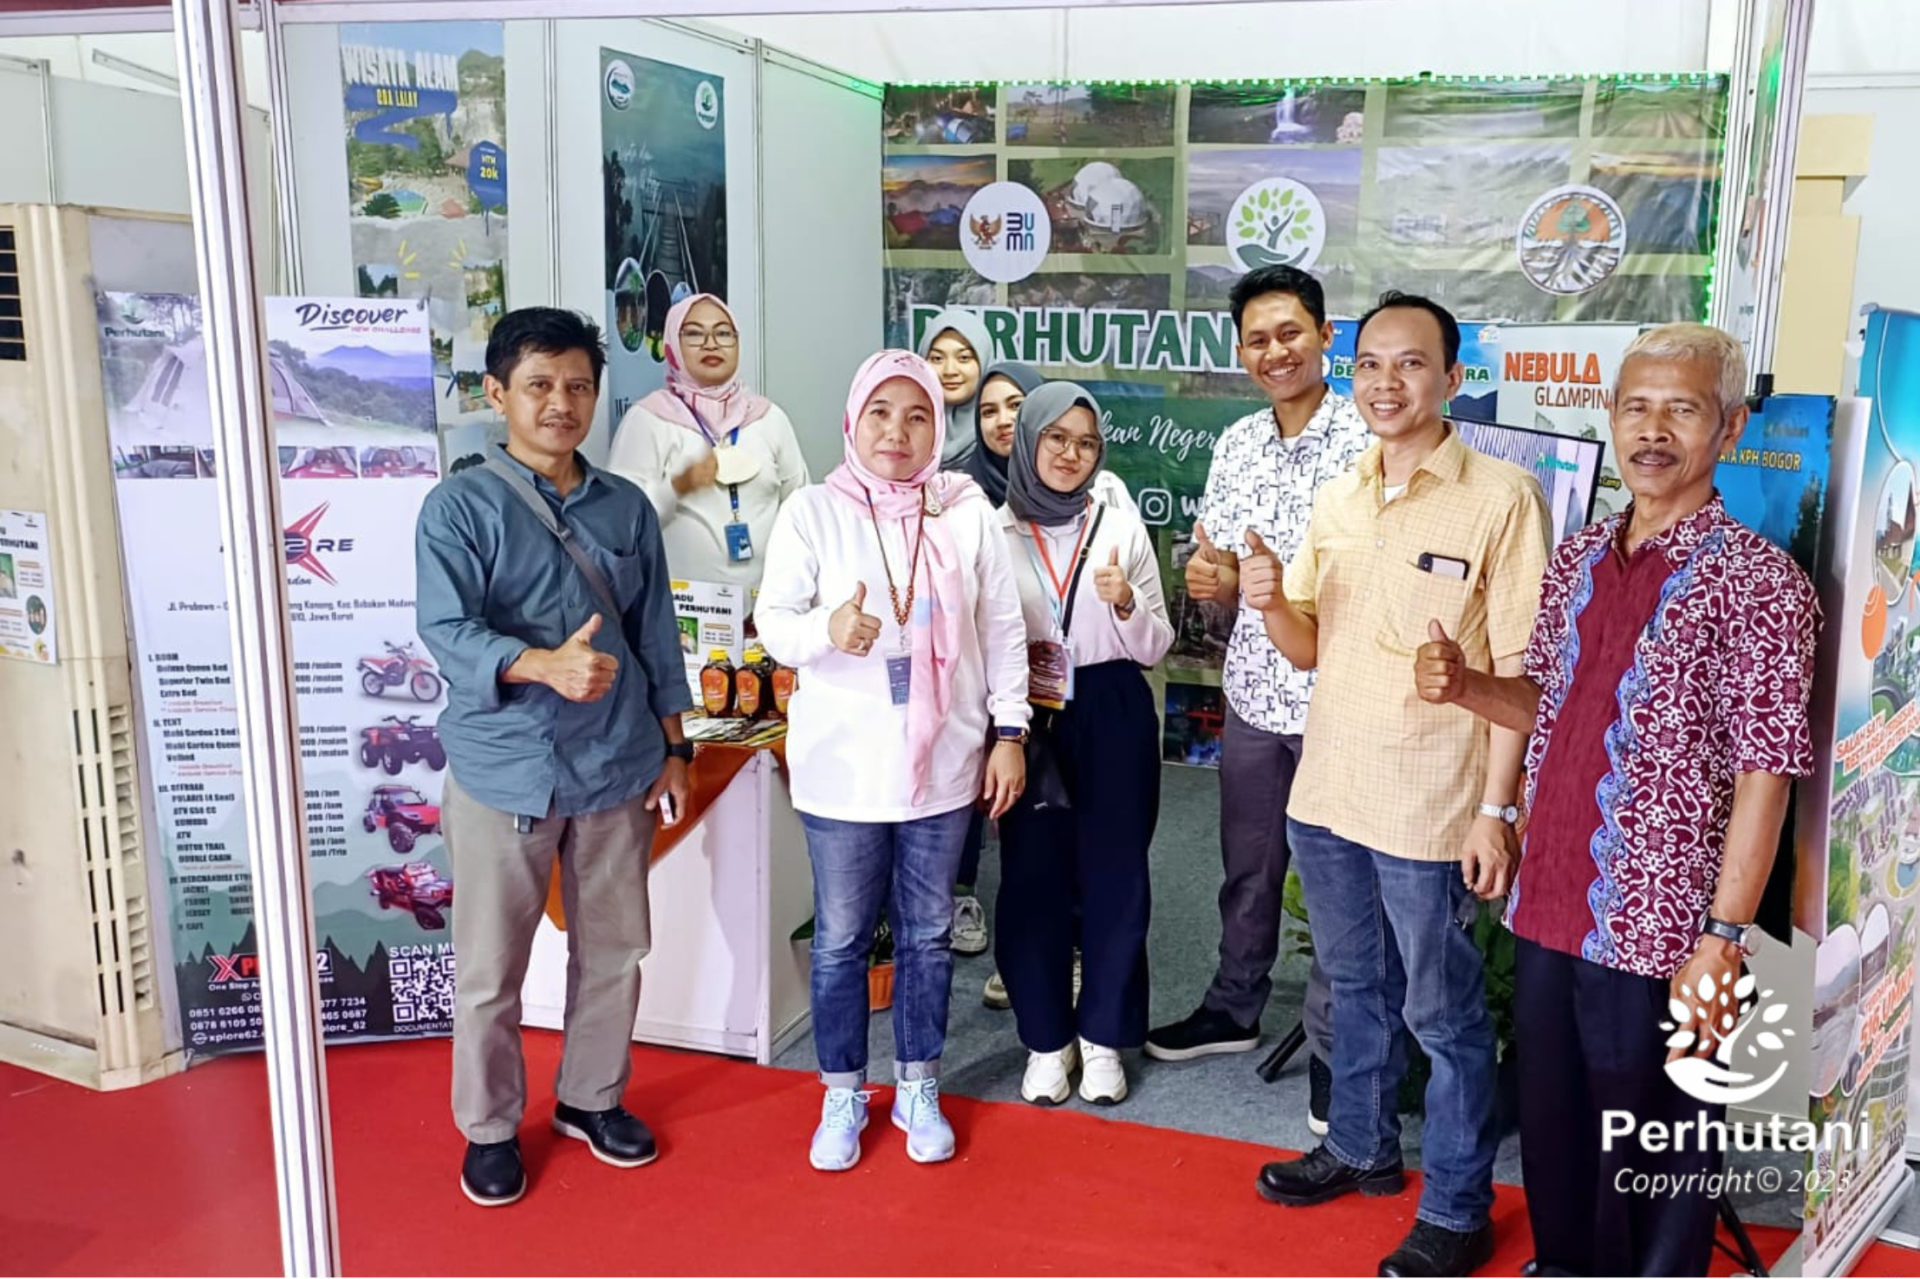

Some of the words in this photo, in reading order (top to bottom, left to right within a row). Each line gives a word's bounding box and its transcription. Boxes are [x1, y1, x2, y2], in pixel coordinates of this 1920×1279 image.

[340, 44, 411, 88] WISATA
[415, 50, 459, 92] ALAM
[295, 303, 408, 329] Discover
[910, 304, 1243, 373] PRHUTAN
[1332, 363, 1356, 379] DE
[1466, 367, 1490, 381] RA
[1504, 351, 1601, 384] NEBULA
[1535, 386, 1612, 410] GLAMPIN
[1100, 410, 1142, 444] kan
[1148, 415, 1222, 462] Neger
[1739, 448, 1759, 465] KPH
[1761, 451, 1801, 471] BOGOR
[673, 594, 694, 602] ADU
[679, 604, 732, 616] PERHUTANI
[389, 944, 433, 958] SCAN
[247, 1005, 262, 1014] 08
[209, 1030, 265, 1043] xplore62.
[393, 1022, 454, 1033] DOCUMENTAT
